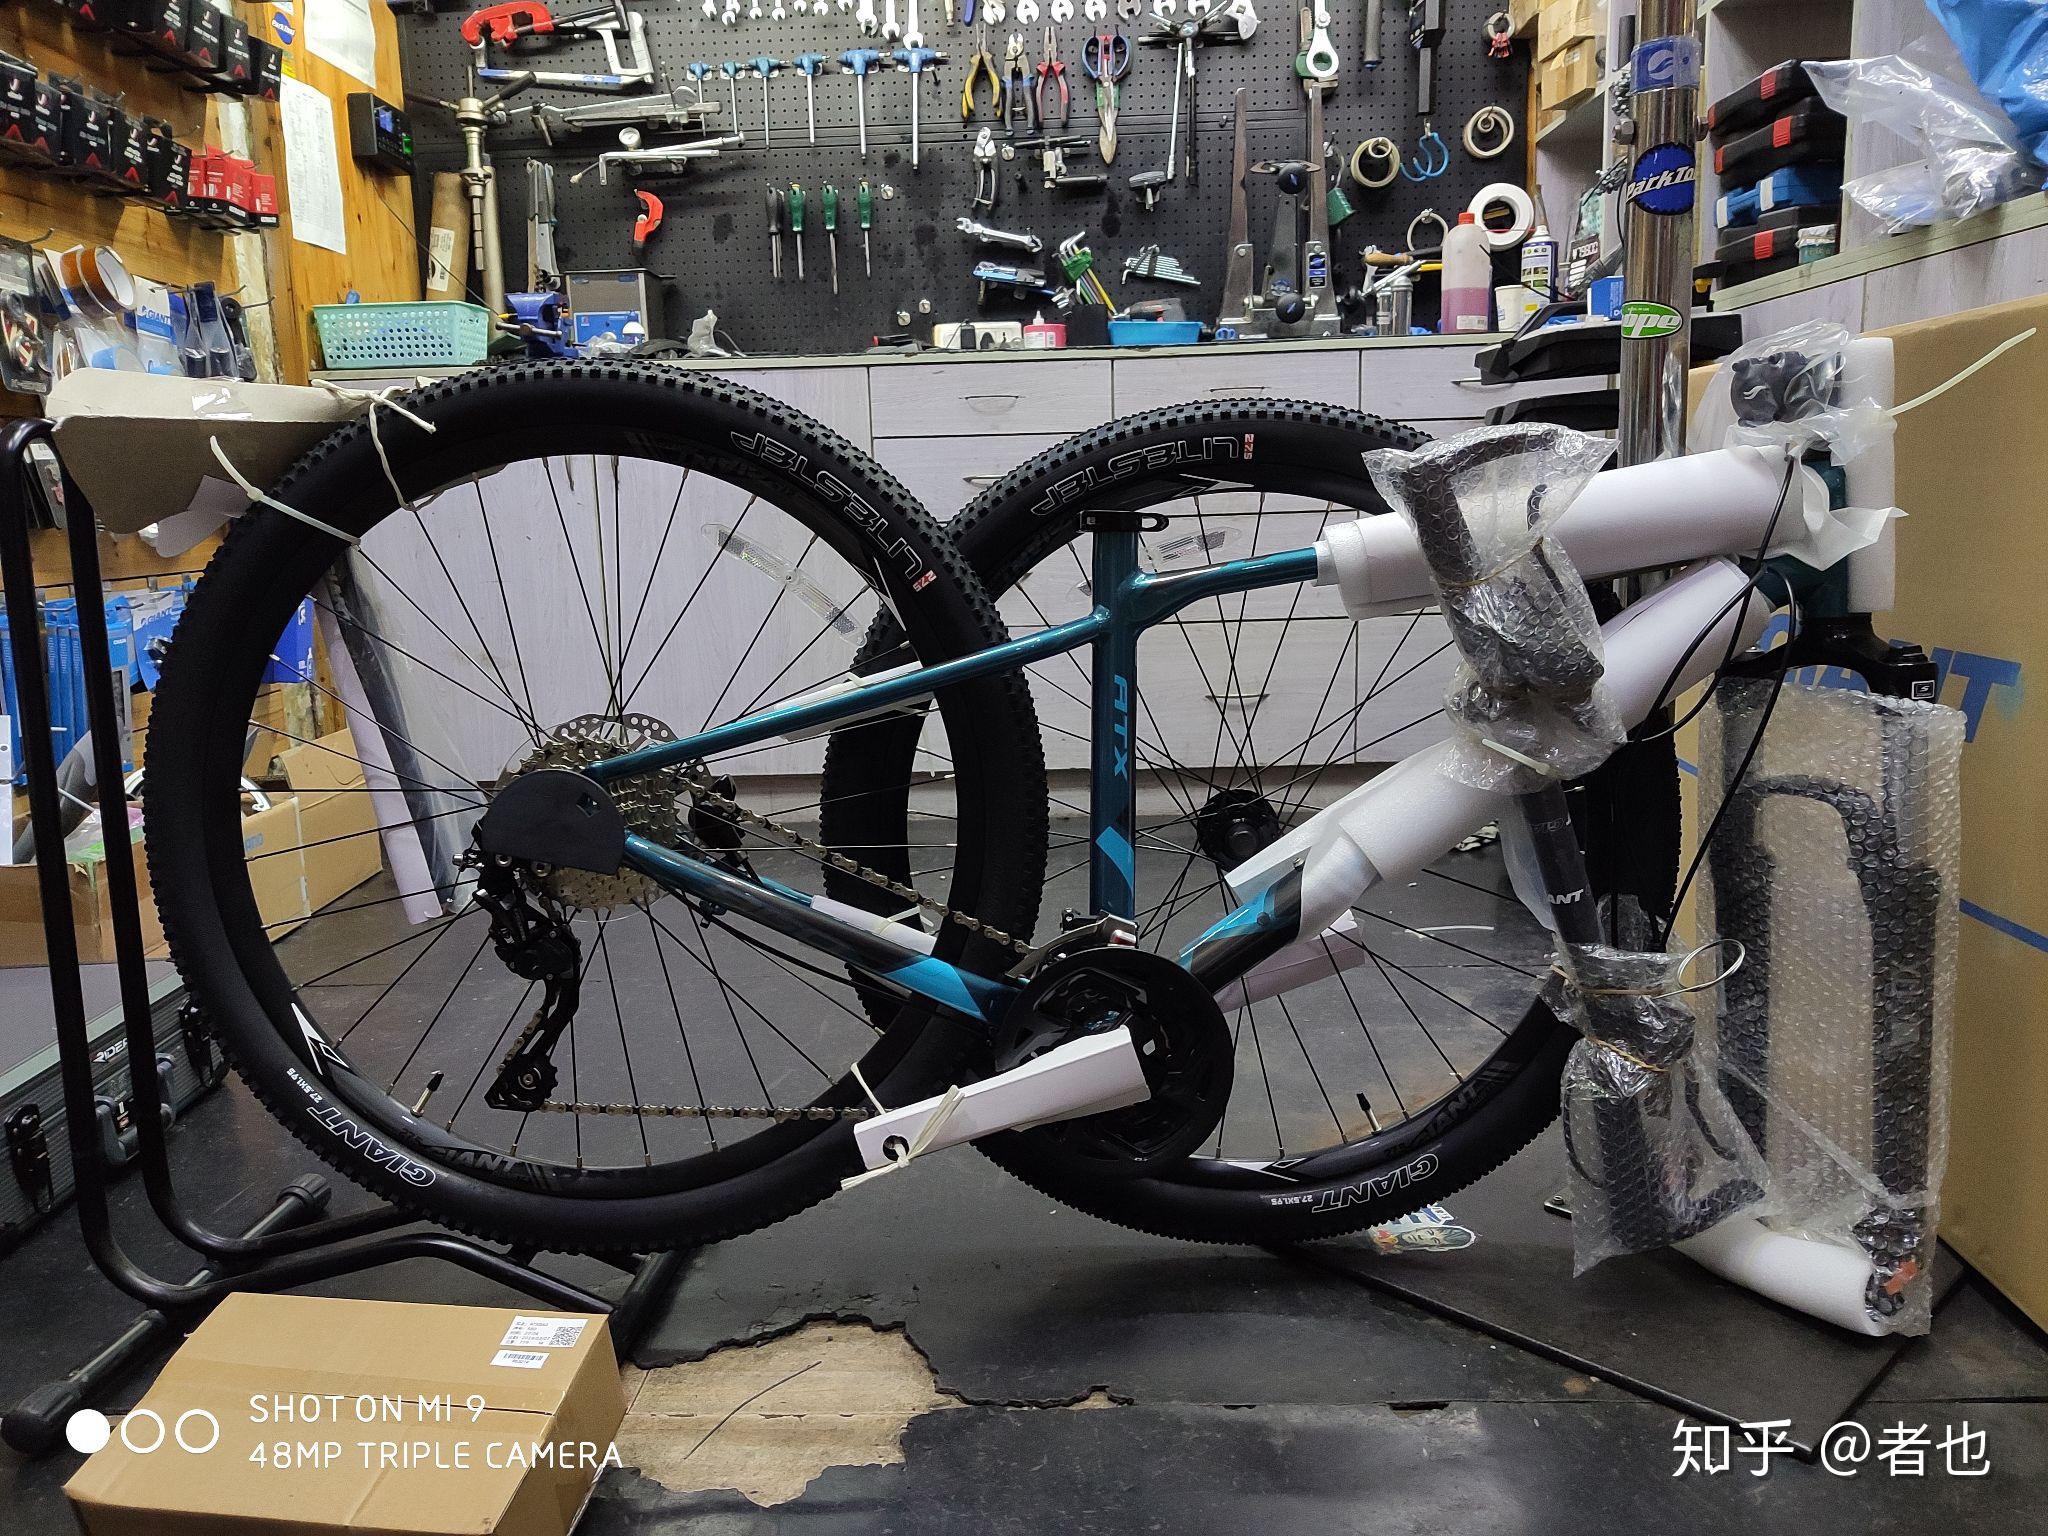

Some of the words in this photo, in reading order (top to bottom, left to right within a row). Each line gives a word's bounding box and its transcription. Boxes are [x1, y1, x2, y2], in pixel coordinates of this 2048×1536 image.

[1113, 674, 1129, 783] ATX
[306, 1106, 437, 1188] GIANT
[1311, 1152, 1440, 1214] GIANT
